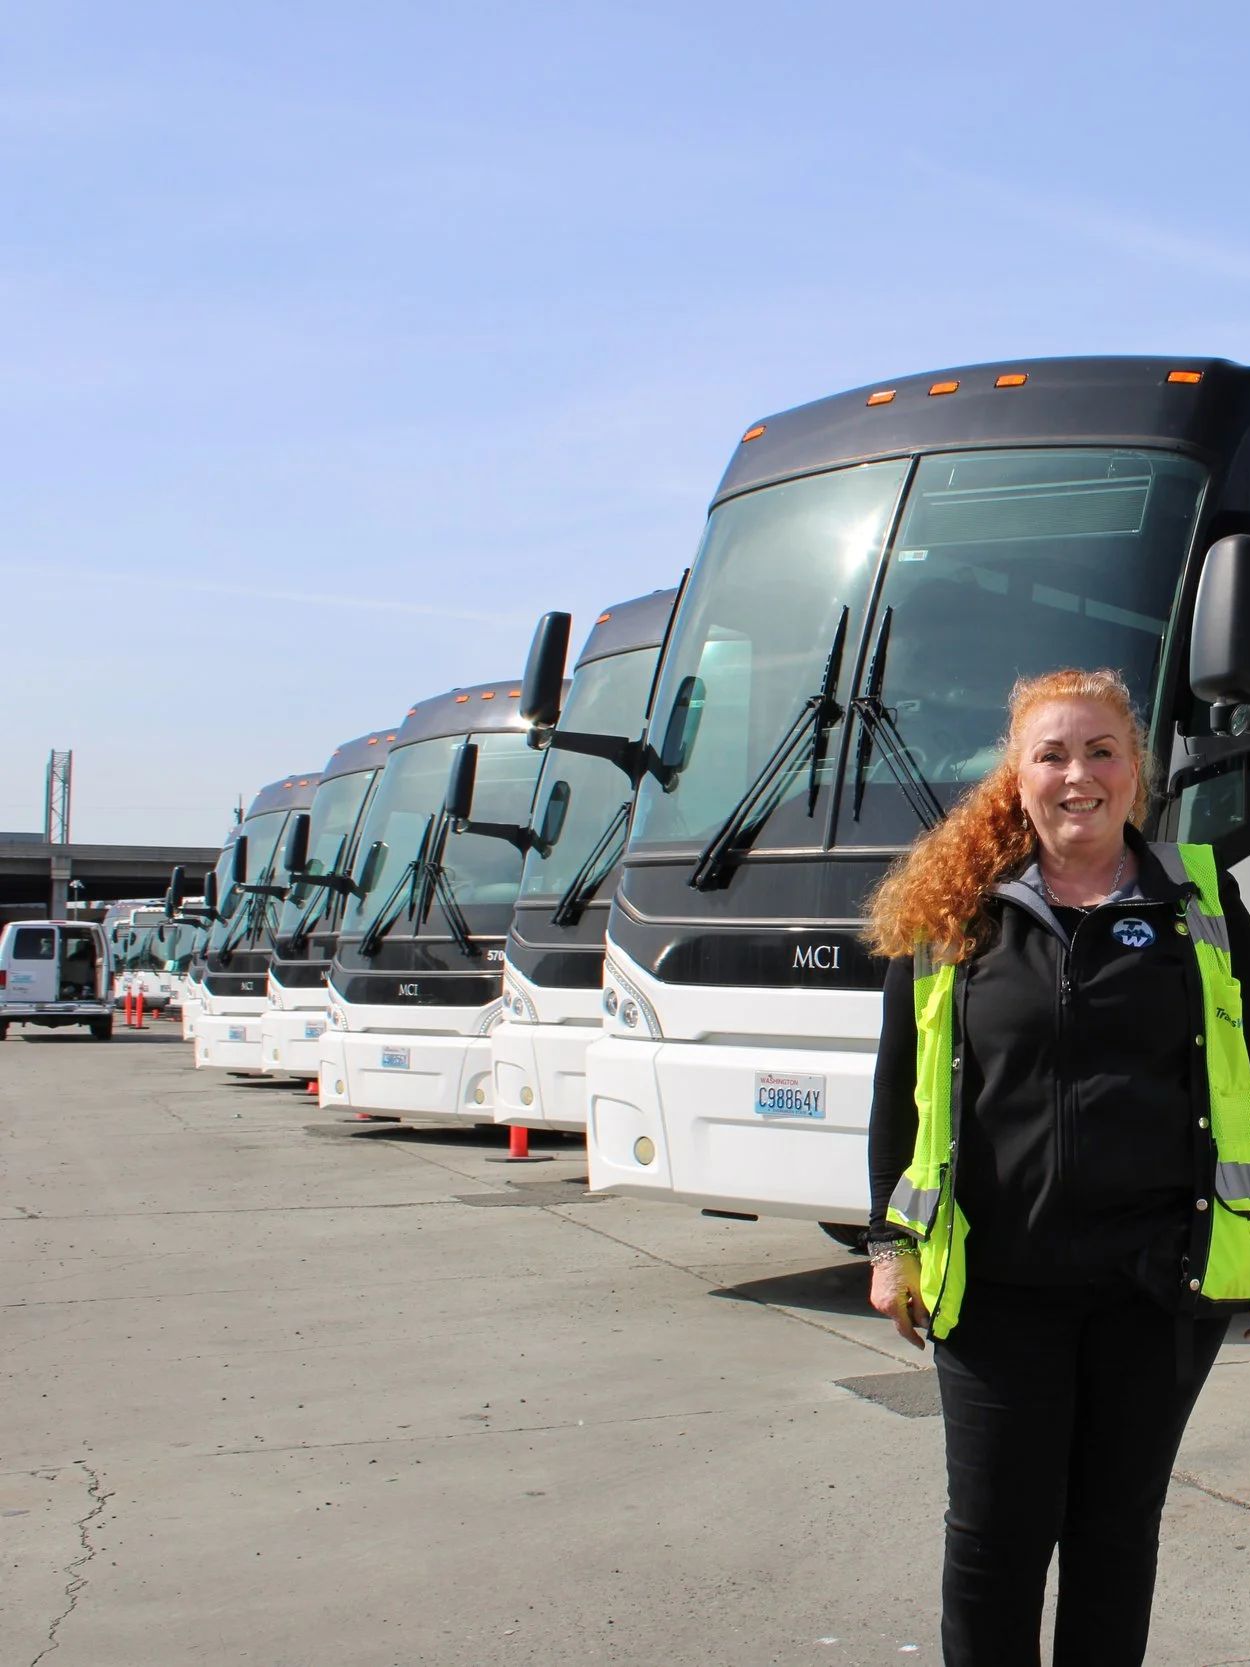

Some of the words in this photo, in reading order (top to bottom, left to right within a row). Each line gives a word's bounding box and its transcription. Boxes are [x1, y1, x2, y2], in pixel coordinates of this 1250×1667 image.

[488, 950, 505, 961] 570
[792, 945, 840, 969] MCI
[398, 983, 418, 996] MCI
[760, 1077, 799, 1086] WASHINGTON
[759, 1087, 820, 1112] C98864Y
